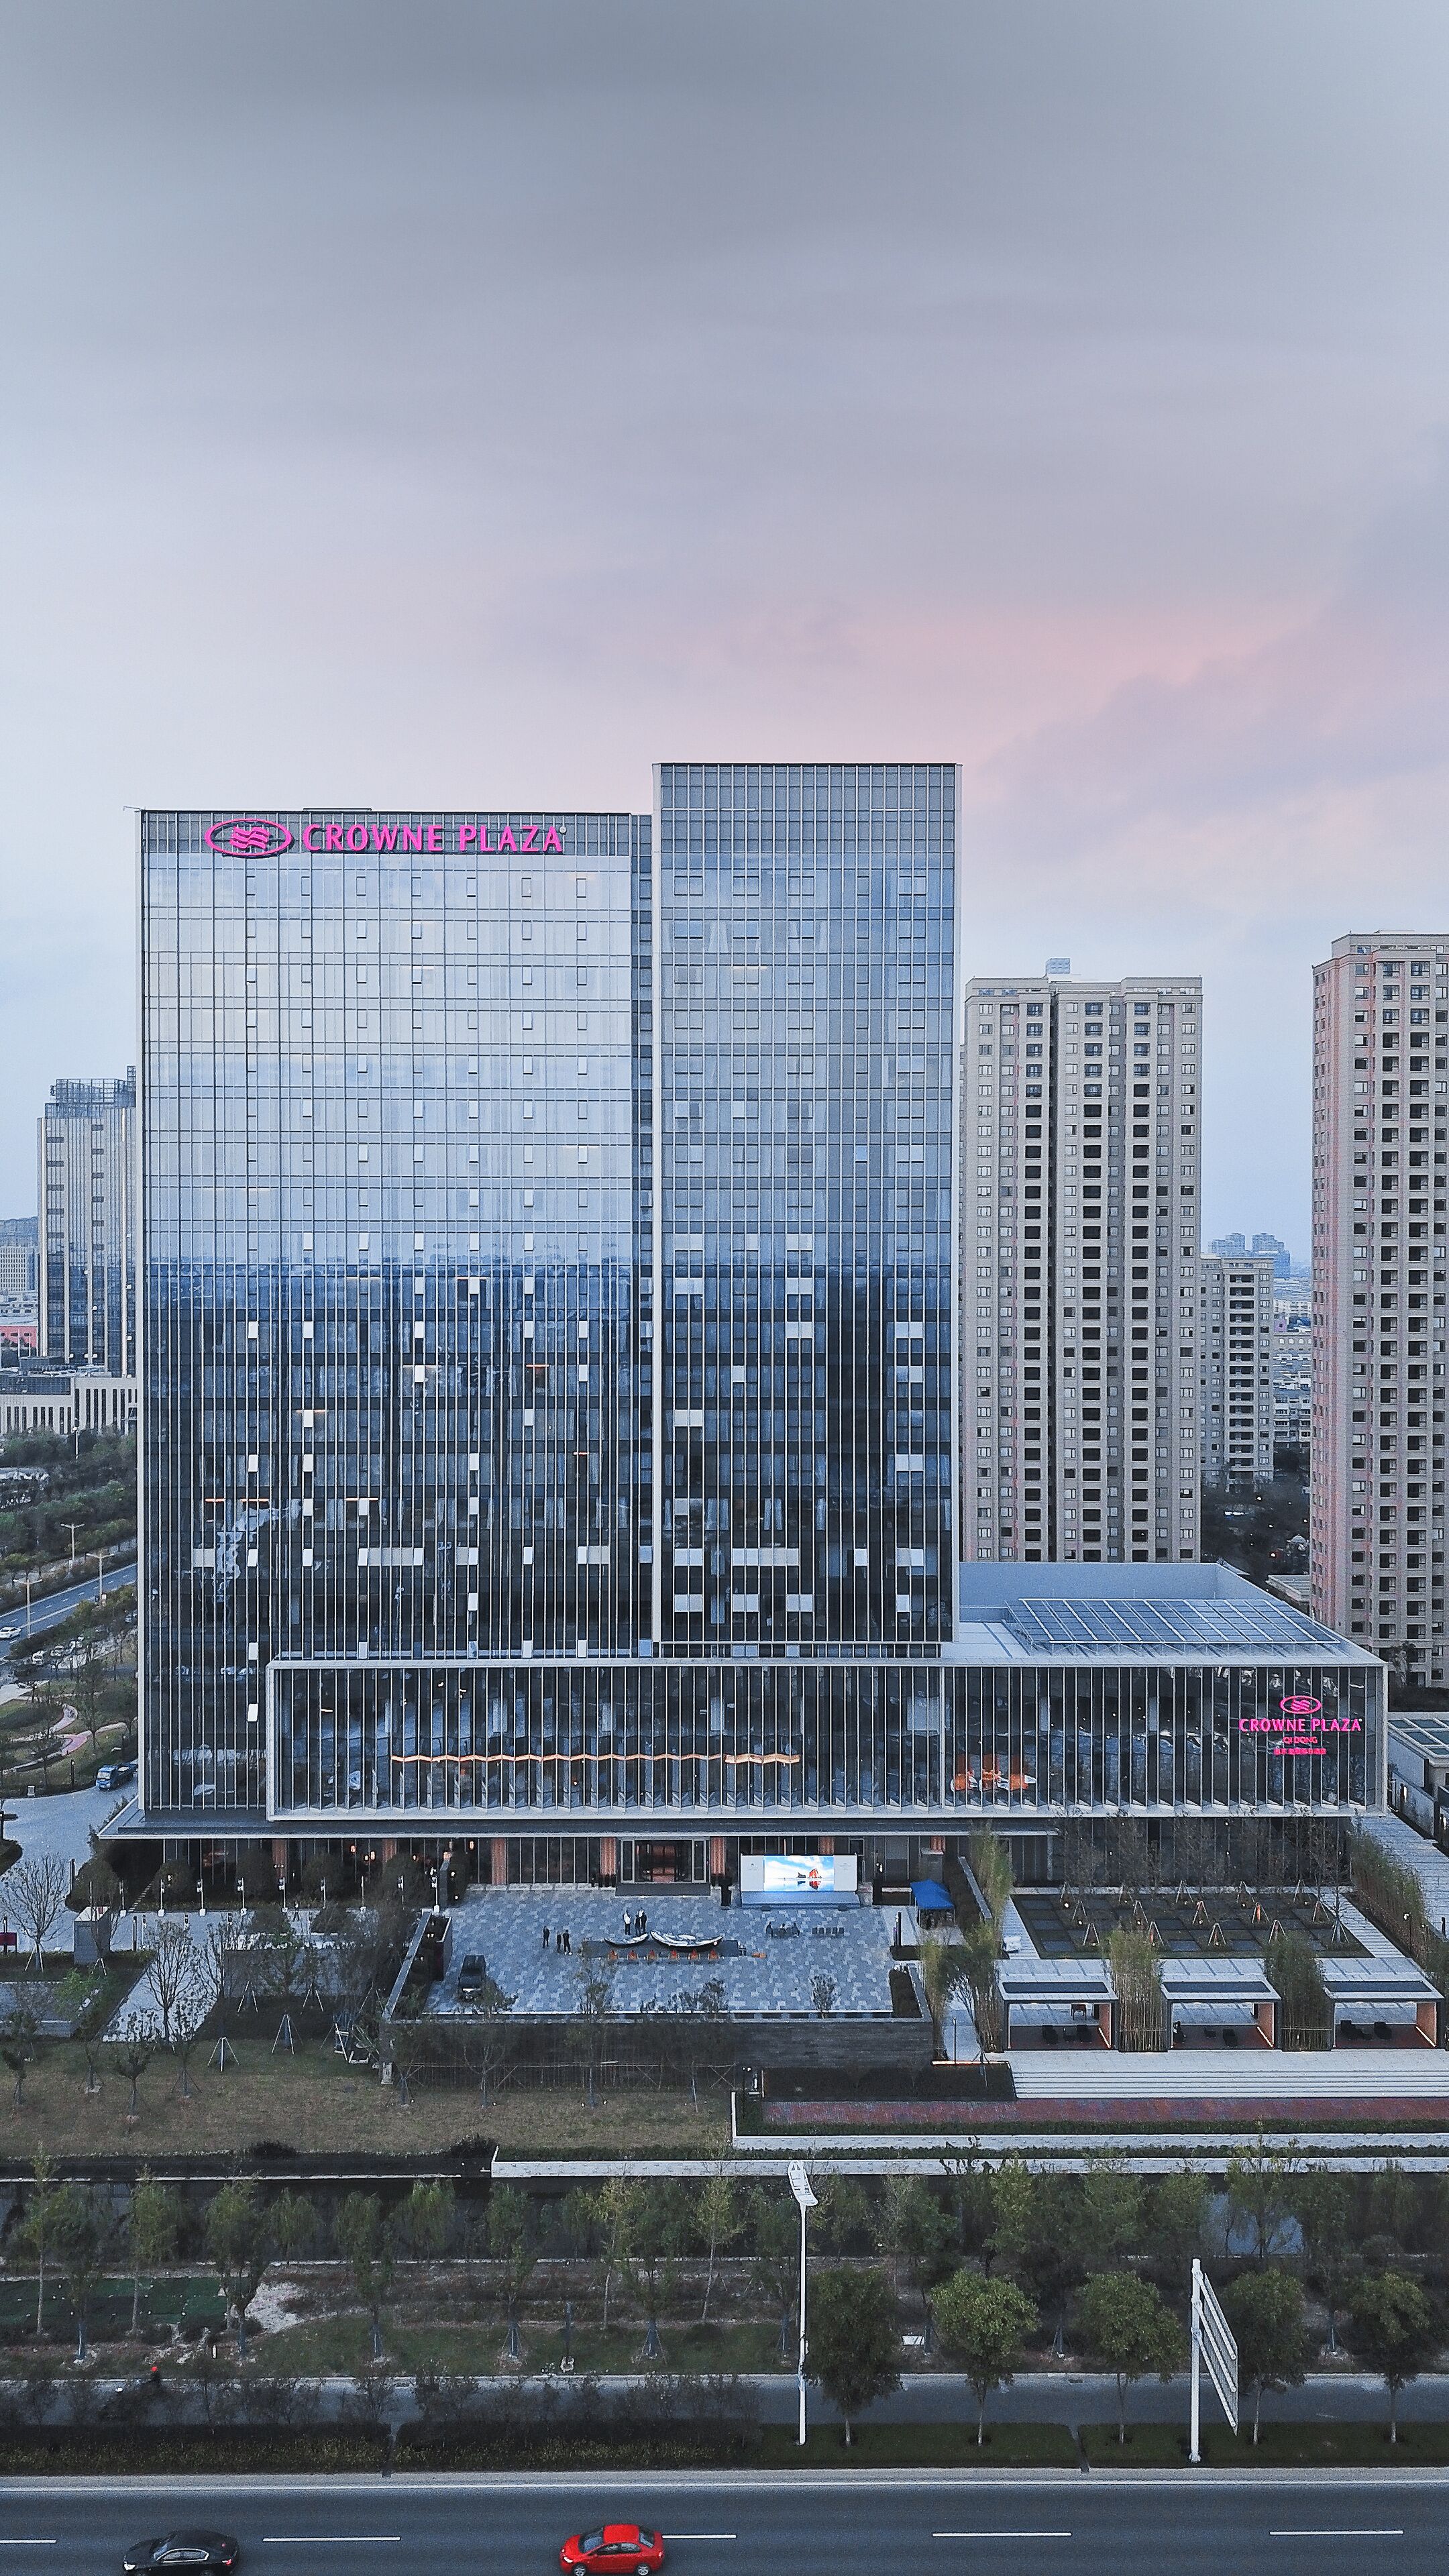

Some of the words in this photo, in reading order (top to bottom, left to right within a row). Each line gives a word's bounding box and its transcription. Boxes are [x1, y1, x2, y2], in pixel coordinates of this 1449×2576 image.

[303, 824, 443, 852] CROWNE
[459, 824, 562, 853] PLAZA
[1239, 1718, 1305, 1732] CROWNE
[1311, 1718, 1361, 1732] PLAZA
